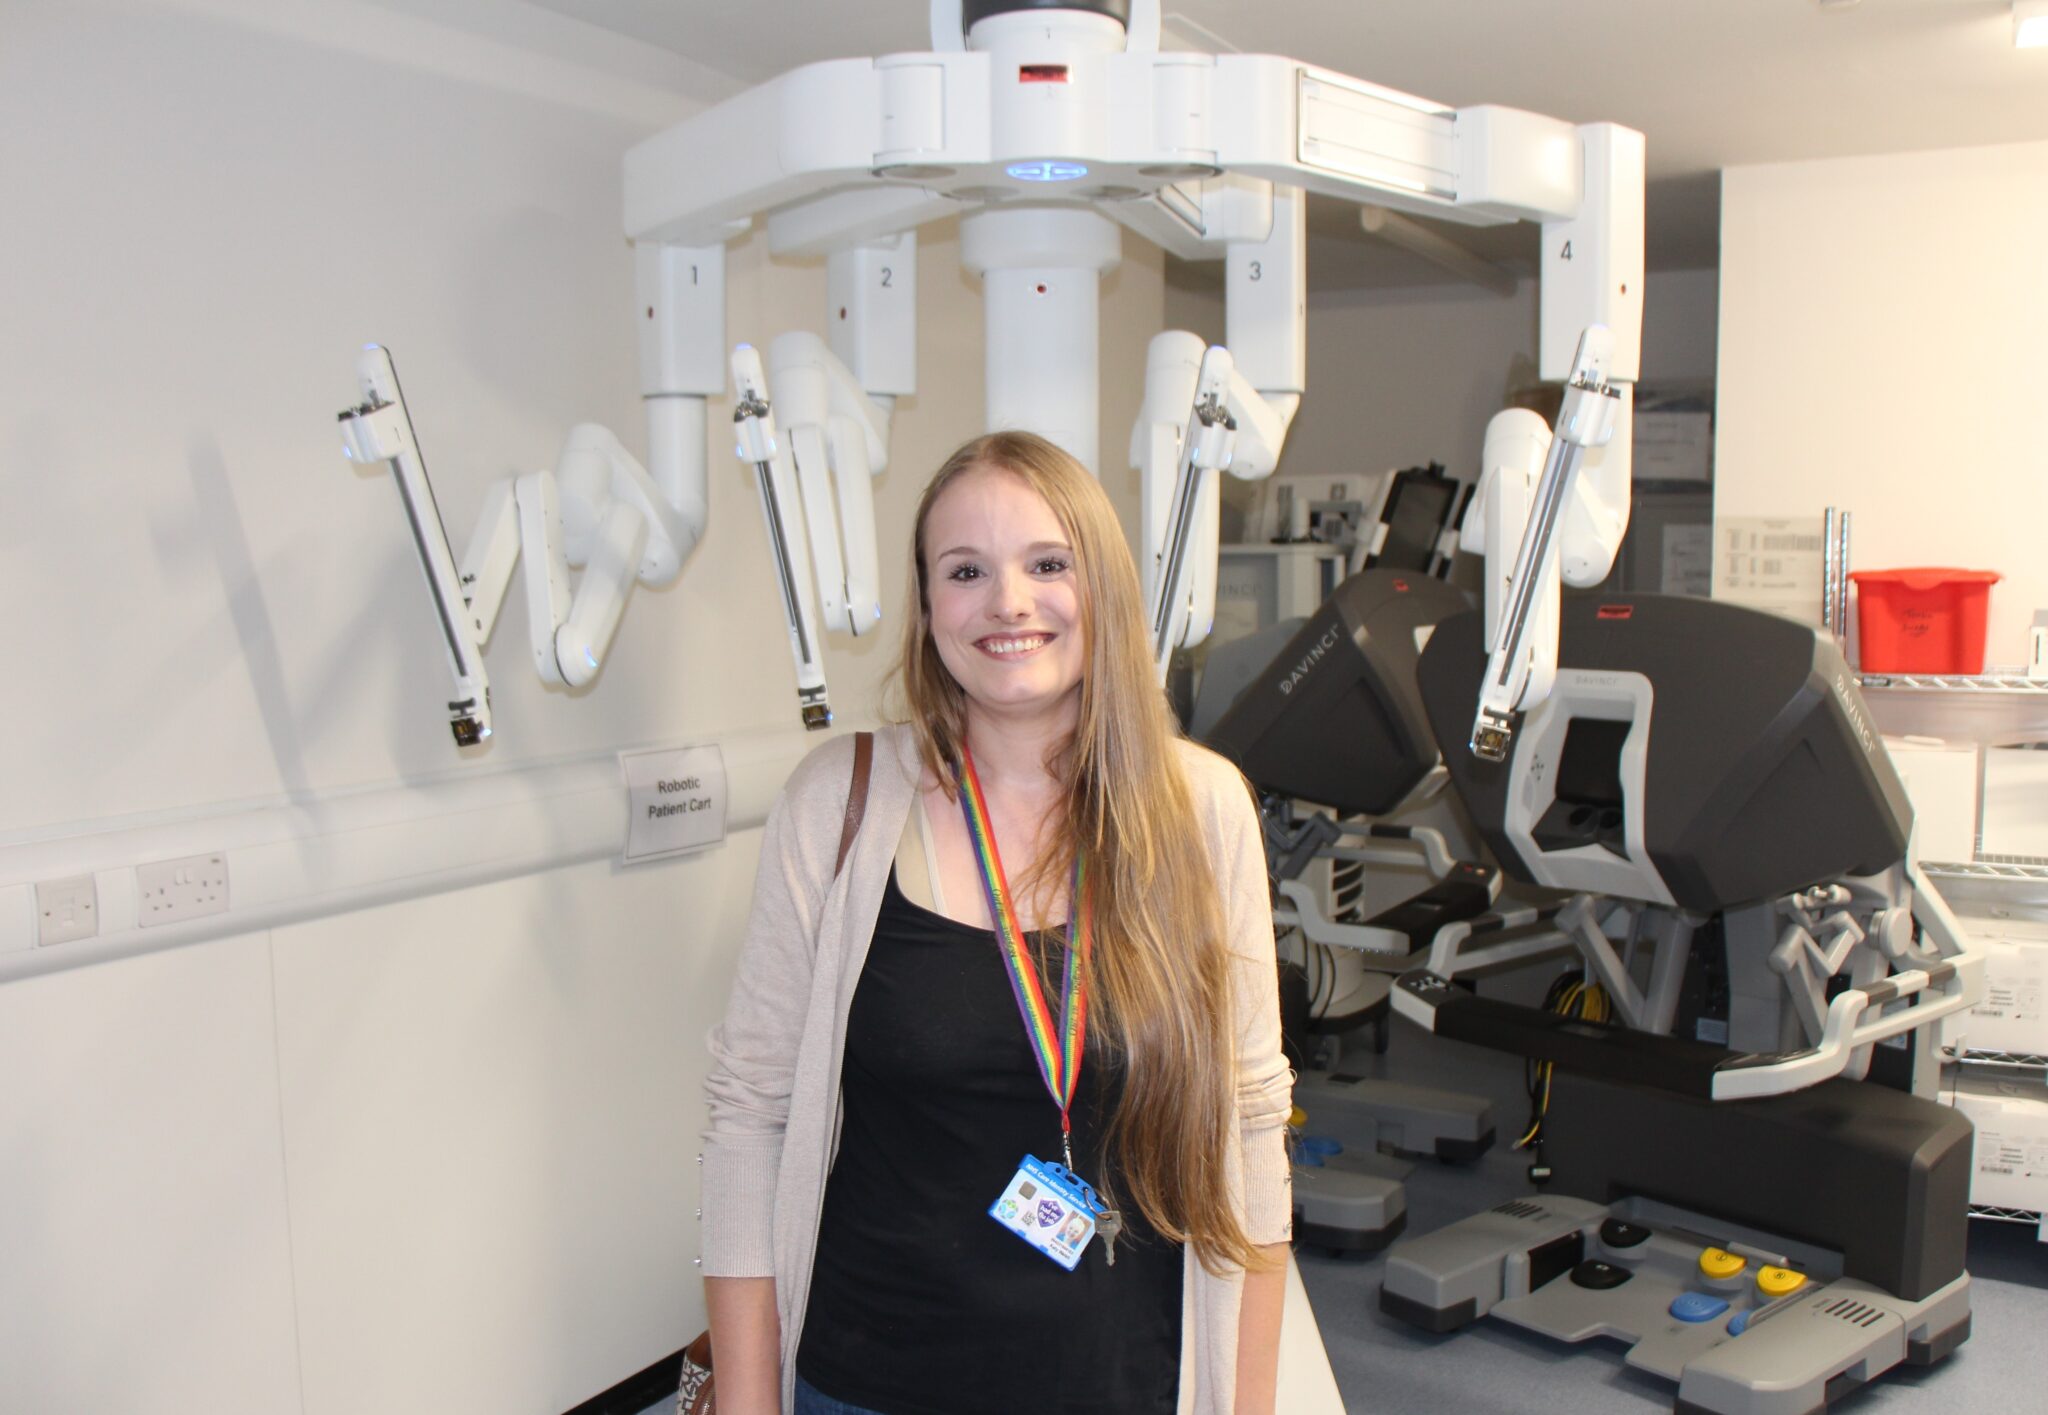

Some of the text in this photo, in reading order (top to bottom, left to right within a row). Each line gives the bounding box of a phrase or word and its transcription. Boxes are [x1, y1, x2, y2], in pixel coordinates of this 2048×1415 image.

[1561, 240, 1573, 260] 4
[692, 265, 697, 285] 1
[881, 267, 892, 288] 2
[1250, 261, 1261, 281] 3
[657, 777, 701, 794] Robotic
[648, 798, 712, 819] Patient Cart
[1037, 1171, 1050, 1182] Care
[1048, 1178, 1070, 1196] Identity
[1068, 1192, 1087, 1208] Service
